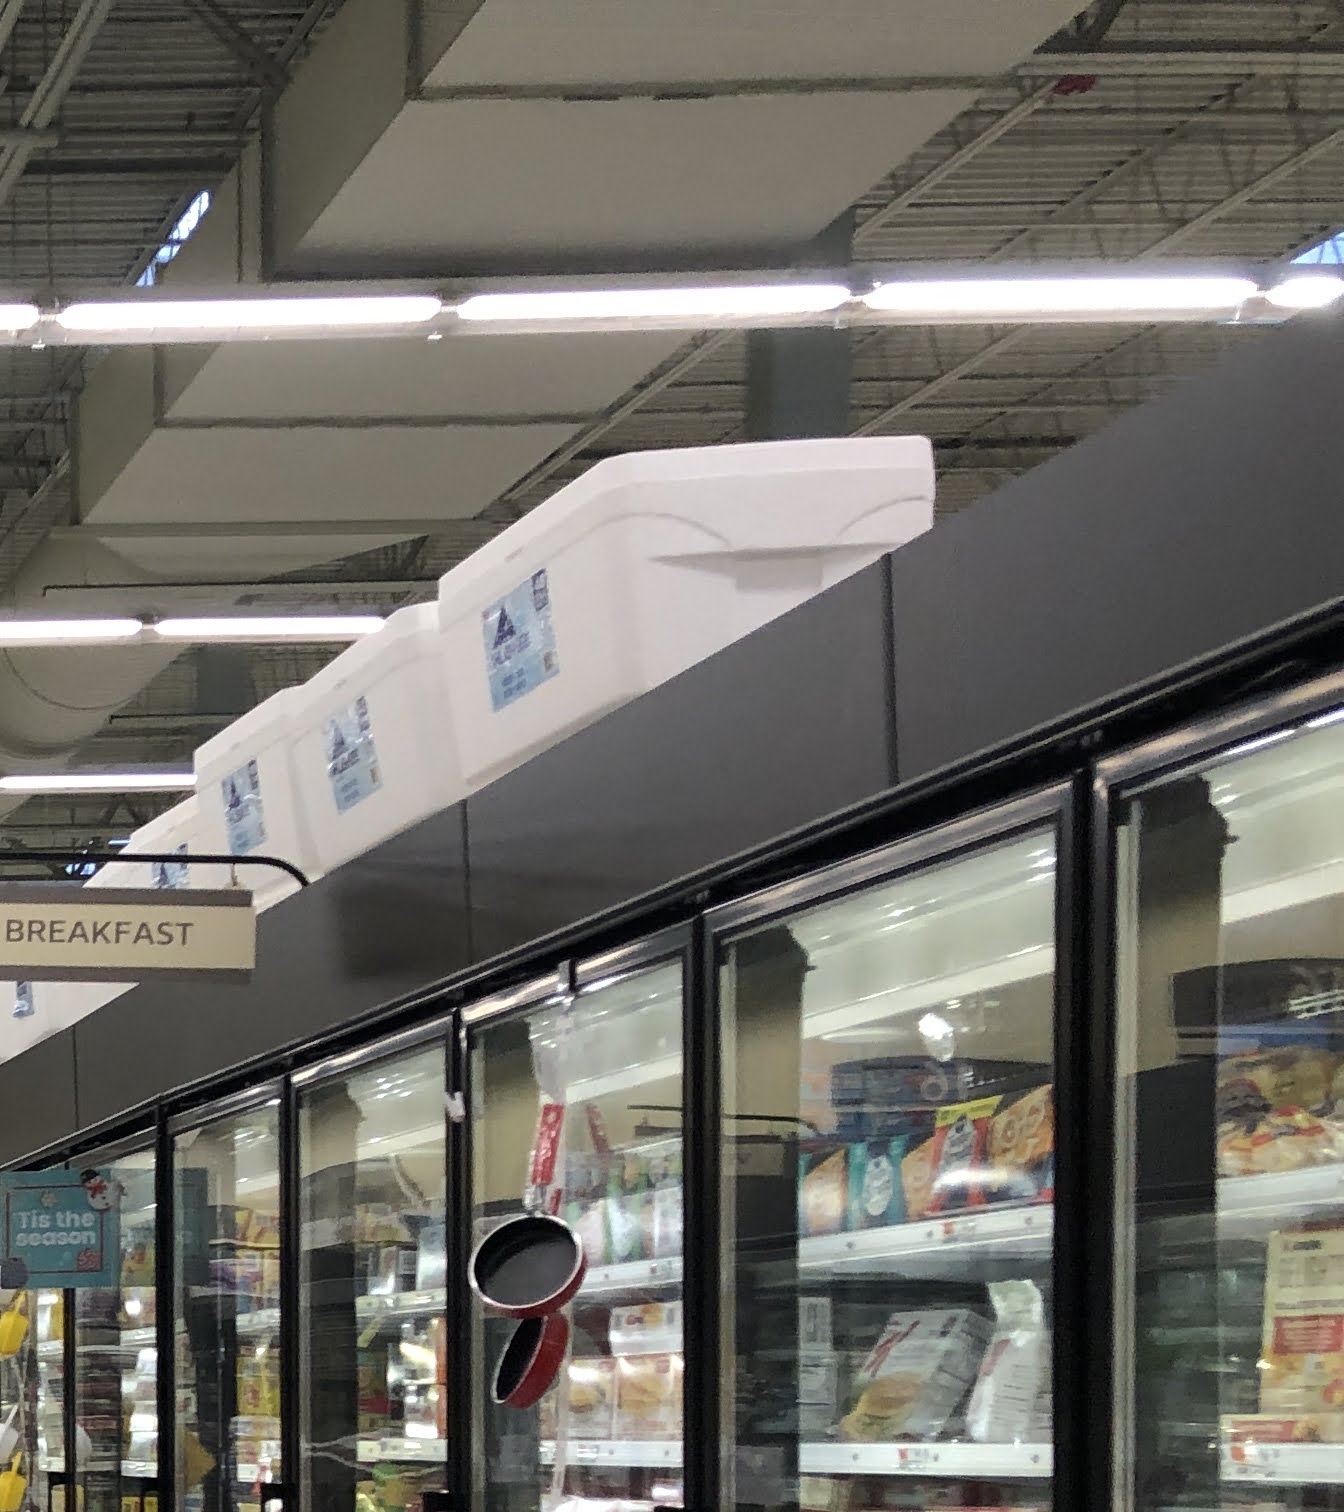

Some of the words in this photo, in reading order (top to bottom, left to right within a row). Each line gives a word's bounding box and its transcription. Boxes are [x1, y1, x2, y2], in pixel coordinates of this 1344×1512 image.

[5, 919, 195, 946] BREAKFAST
[56, 1210, 96, 1228] the
[15, 1230, 97, 1247] season
